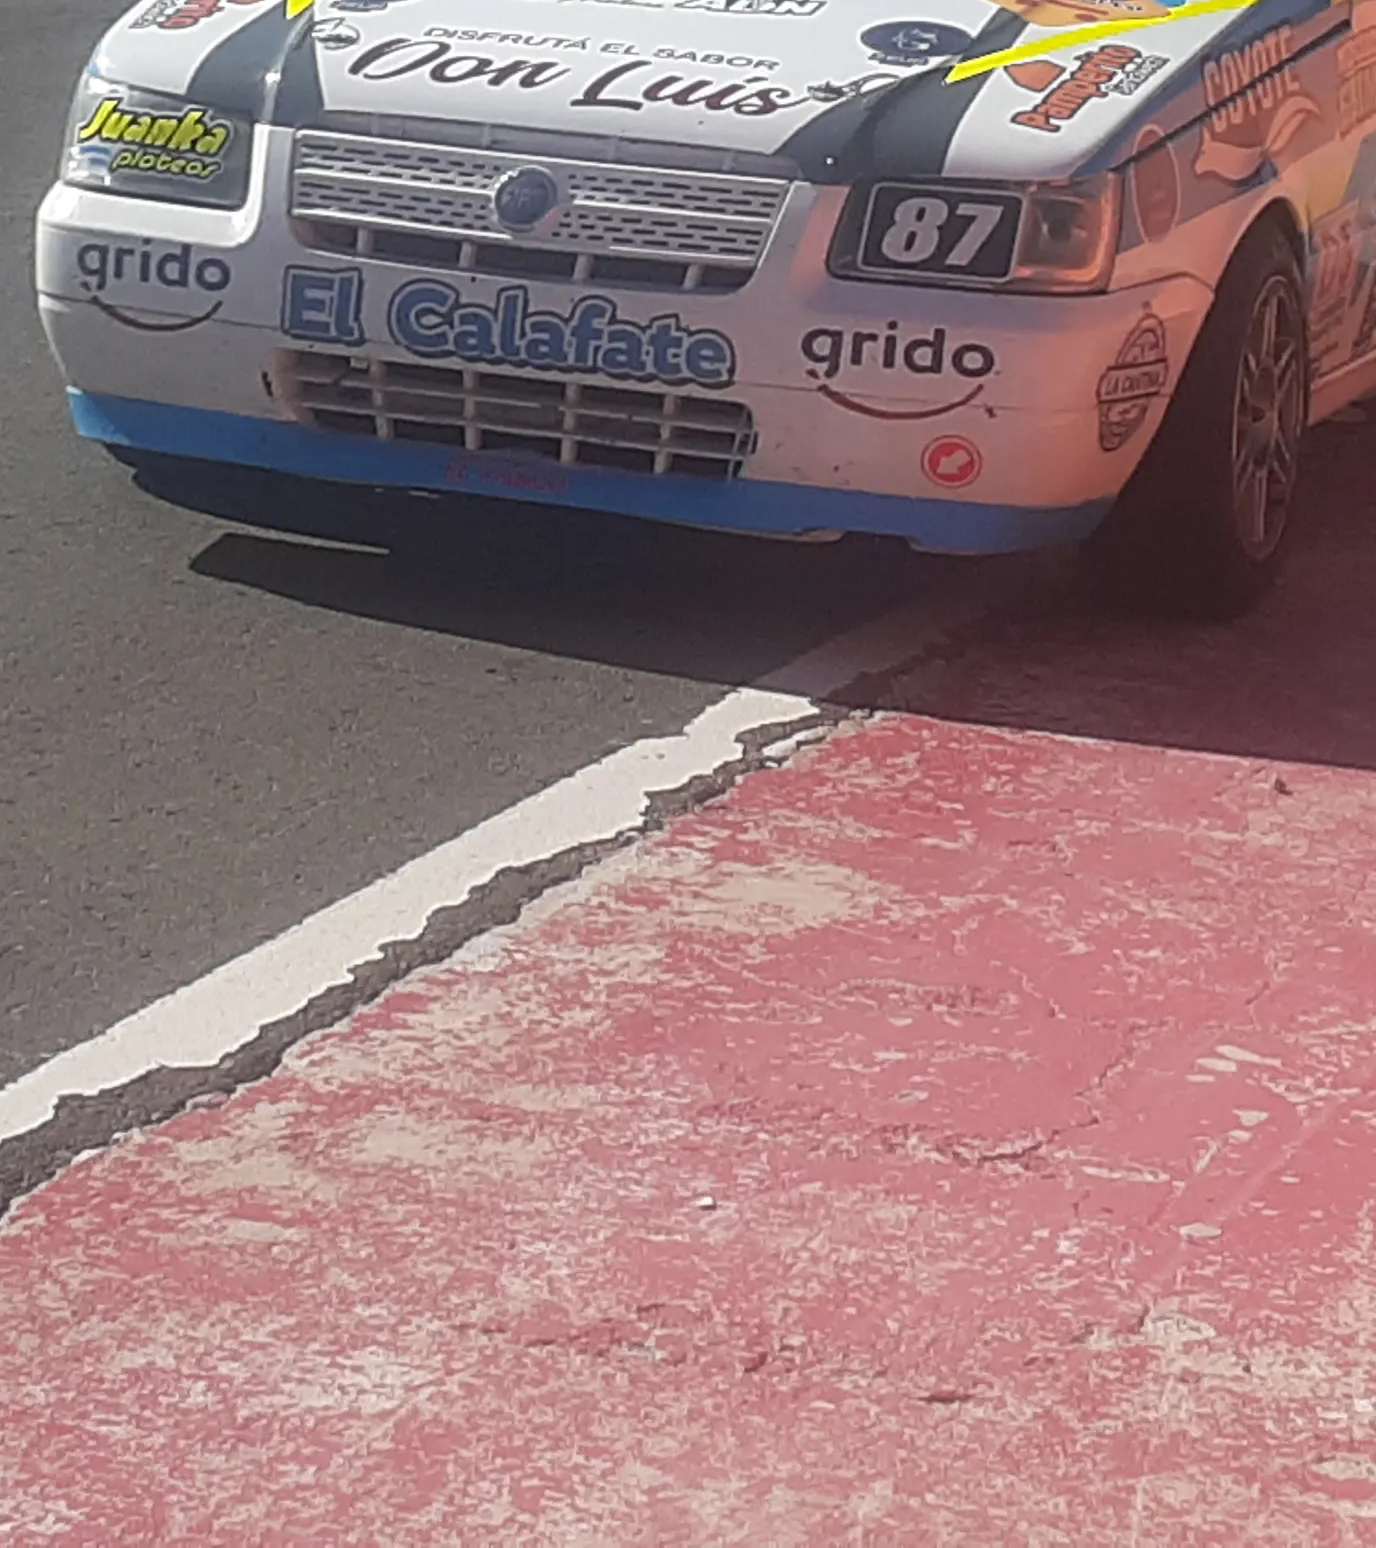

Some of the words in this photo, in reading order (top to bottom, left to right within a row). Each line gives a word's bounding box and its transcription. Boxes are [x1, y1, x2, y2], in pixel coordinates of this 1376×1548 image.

[600, 41, 641, 57] EL
[653, 48, 781, 71] SABOR
[80, 100, 231, 154] Juanka
[880, 197, 1004, 267] 87
[77, 239, 232, 292] grido
[281, 265, 365, 346] El
[387, 278, 737, 388] Calafate
[800, 320, 996, 380] grido
